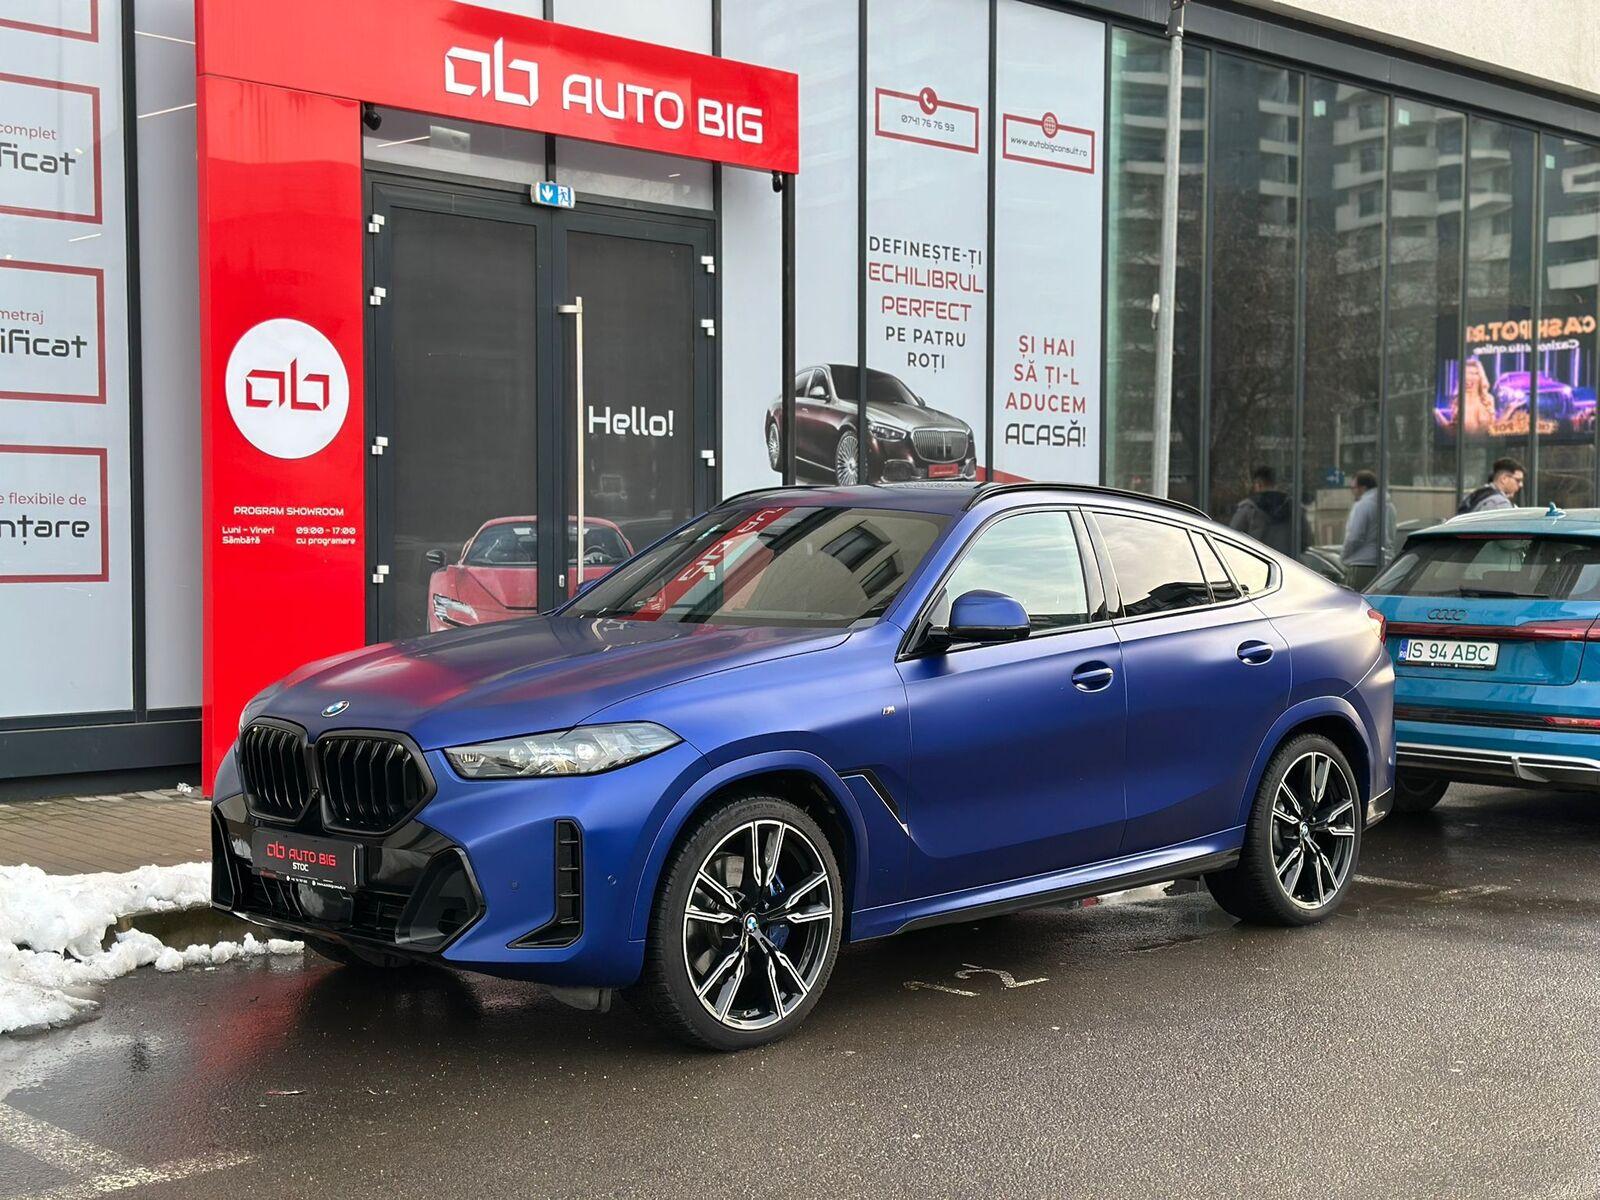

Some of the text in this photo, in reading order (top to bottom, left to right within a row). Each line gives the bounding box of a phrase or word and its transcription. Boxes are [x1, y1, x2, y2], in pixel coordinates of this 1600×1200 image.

[562, 74, 686, 131] AUTO
[698, 97, 764, 145] BIG
[901, 114, 955, 132] 0741 76 76 93
[1010, 136, 1089, 158] www.autobigconsult.ro
[869, 236, 983, 269] DEFINEȘTE-ȚI
[868, 261, 985, 294] ECHILIBRUL
[881, 295, 973, 322] PERFECT
[885, 326, 967, 348] PE PATRU
[1018, 334, 1076, 359] ȘI HAI
[907, 352, 946, 374] ROȚI
[1014, 360, 1080, 389] SĂ ȚI-L
[1005, 391, 1087, 415] ADUCEM
[588, 405, 675, 437] Hello!
[1005, 419, 1087, 448] ACASĂ!
[9, 491, 65, 506] flexibile
[69, 493, 87, 506] de
[233, 506, 345, 517] PROGRAM SHOWROOM
[222, 526, 241, 534] Luni
[249, 526, 275, 535] Vineri
[295, 526, 325, 535] 09:00
[332, 526, 357, 535] 17:00
[1408, 641, 1491, 662] IS 94 ABC
[288, 848, 317, 864] AUTO
[319, 852, 337, 867] BIG
[292, 861, 310, 872] STOC
